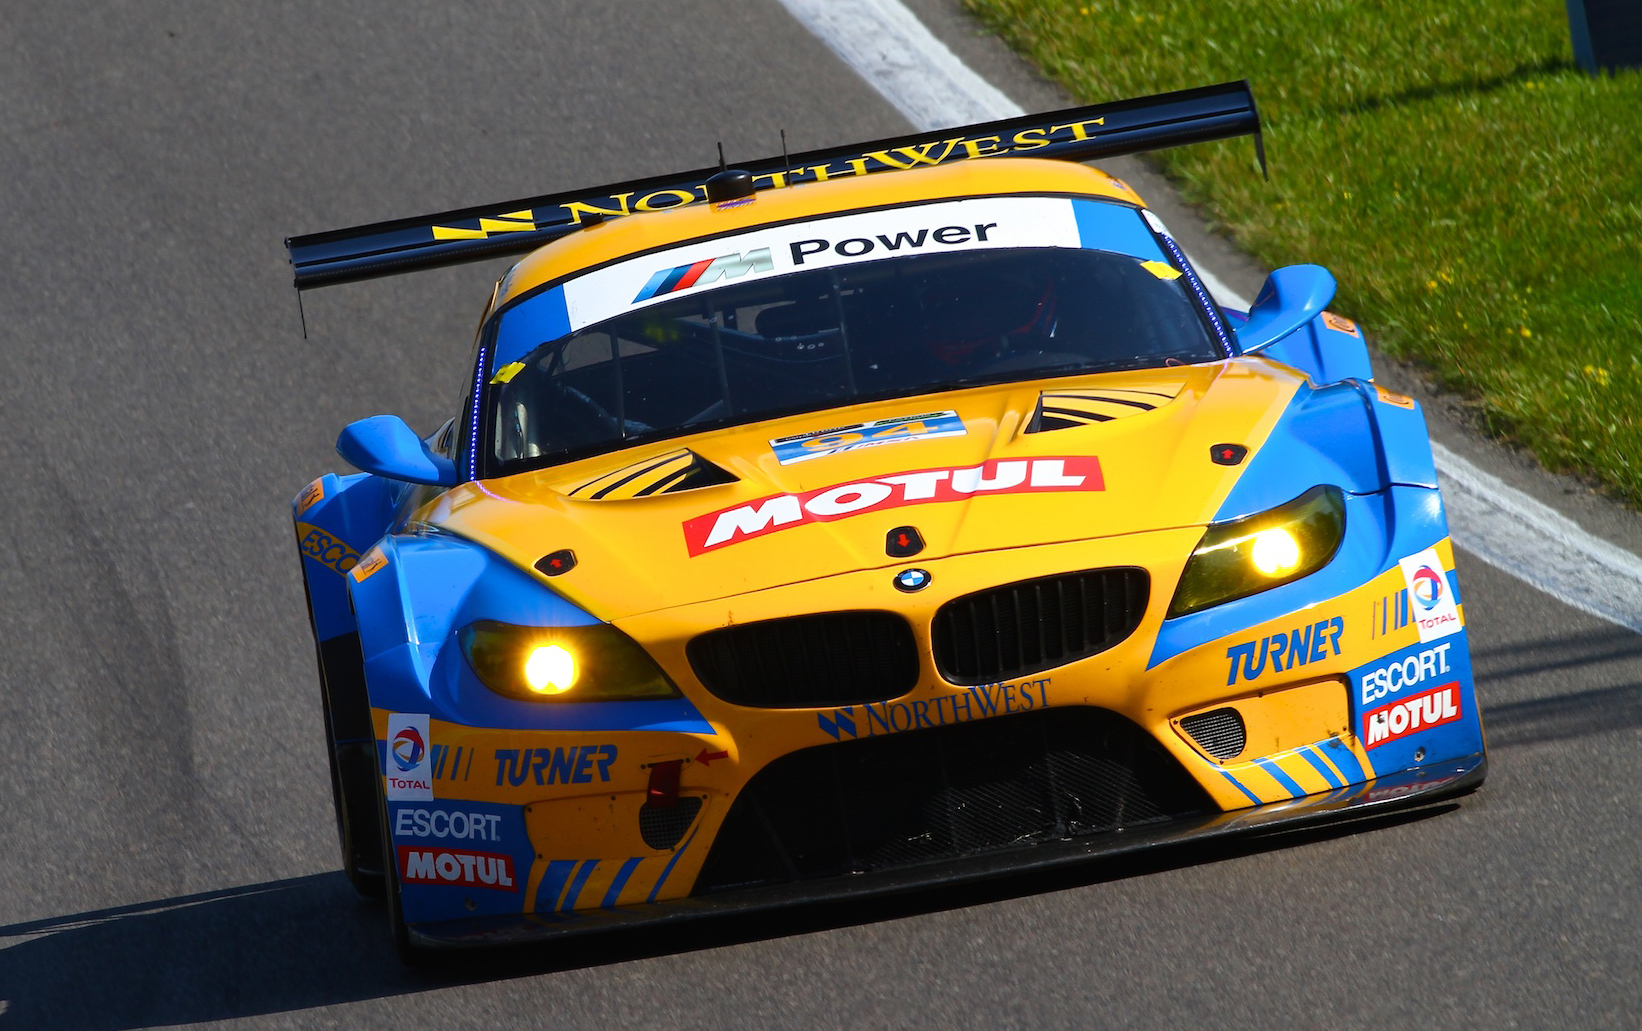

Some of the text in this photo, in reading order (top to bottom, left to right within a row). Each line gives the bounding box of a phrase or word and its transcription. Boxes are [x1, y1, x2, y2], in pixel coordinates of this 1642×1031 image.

[560, 117, 1104, 225] NOTHWEST
[789, 220, 998, 265] Power
[801, 421, 938, 451] 94
[703, 459, 1087, 548] MOTUL
[1418, 613, 1457, 630] TOTAL
[1226, 616, 1344, 686] TURNER
[1361, 643, 1451, 705] ESCORT
[1367, 688, 1457, 746] MOTUL
[389, 778, 430, 789] TOTAL
[495, 744, 618, 787] TURNER
[395, 808, 502, 841] ESCORT
[406, 851, 512, 887] MOTUL
